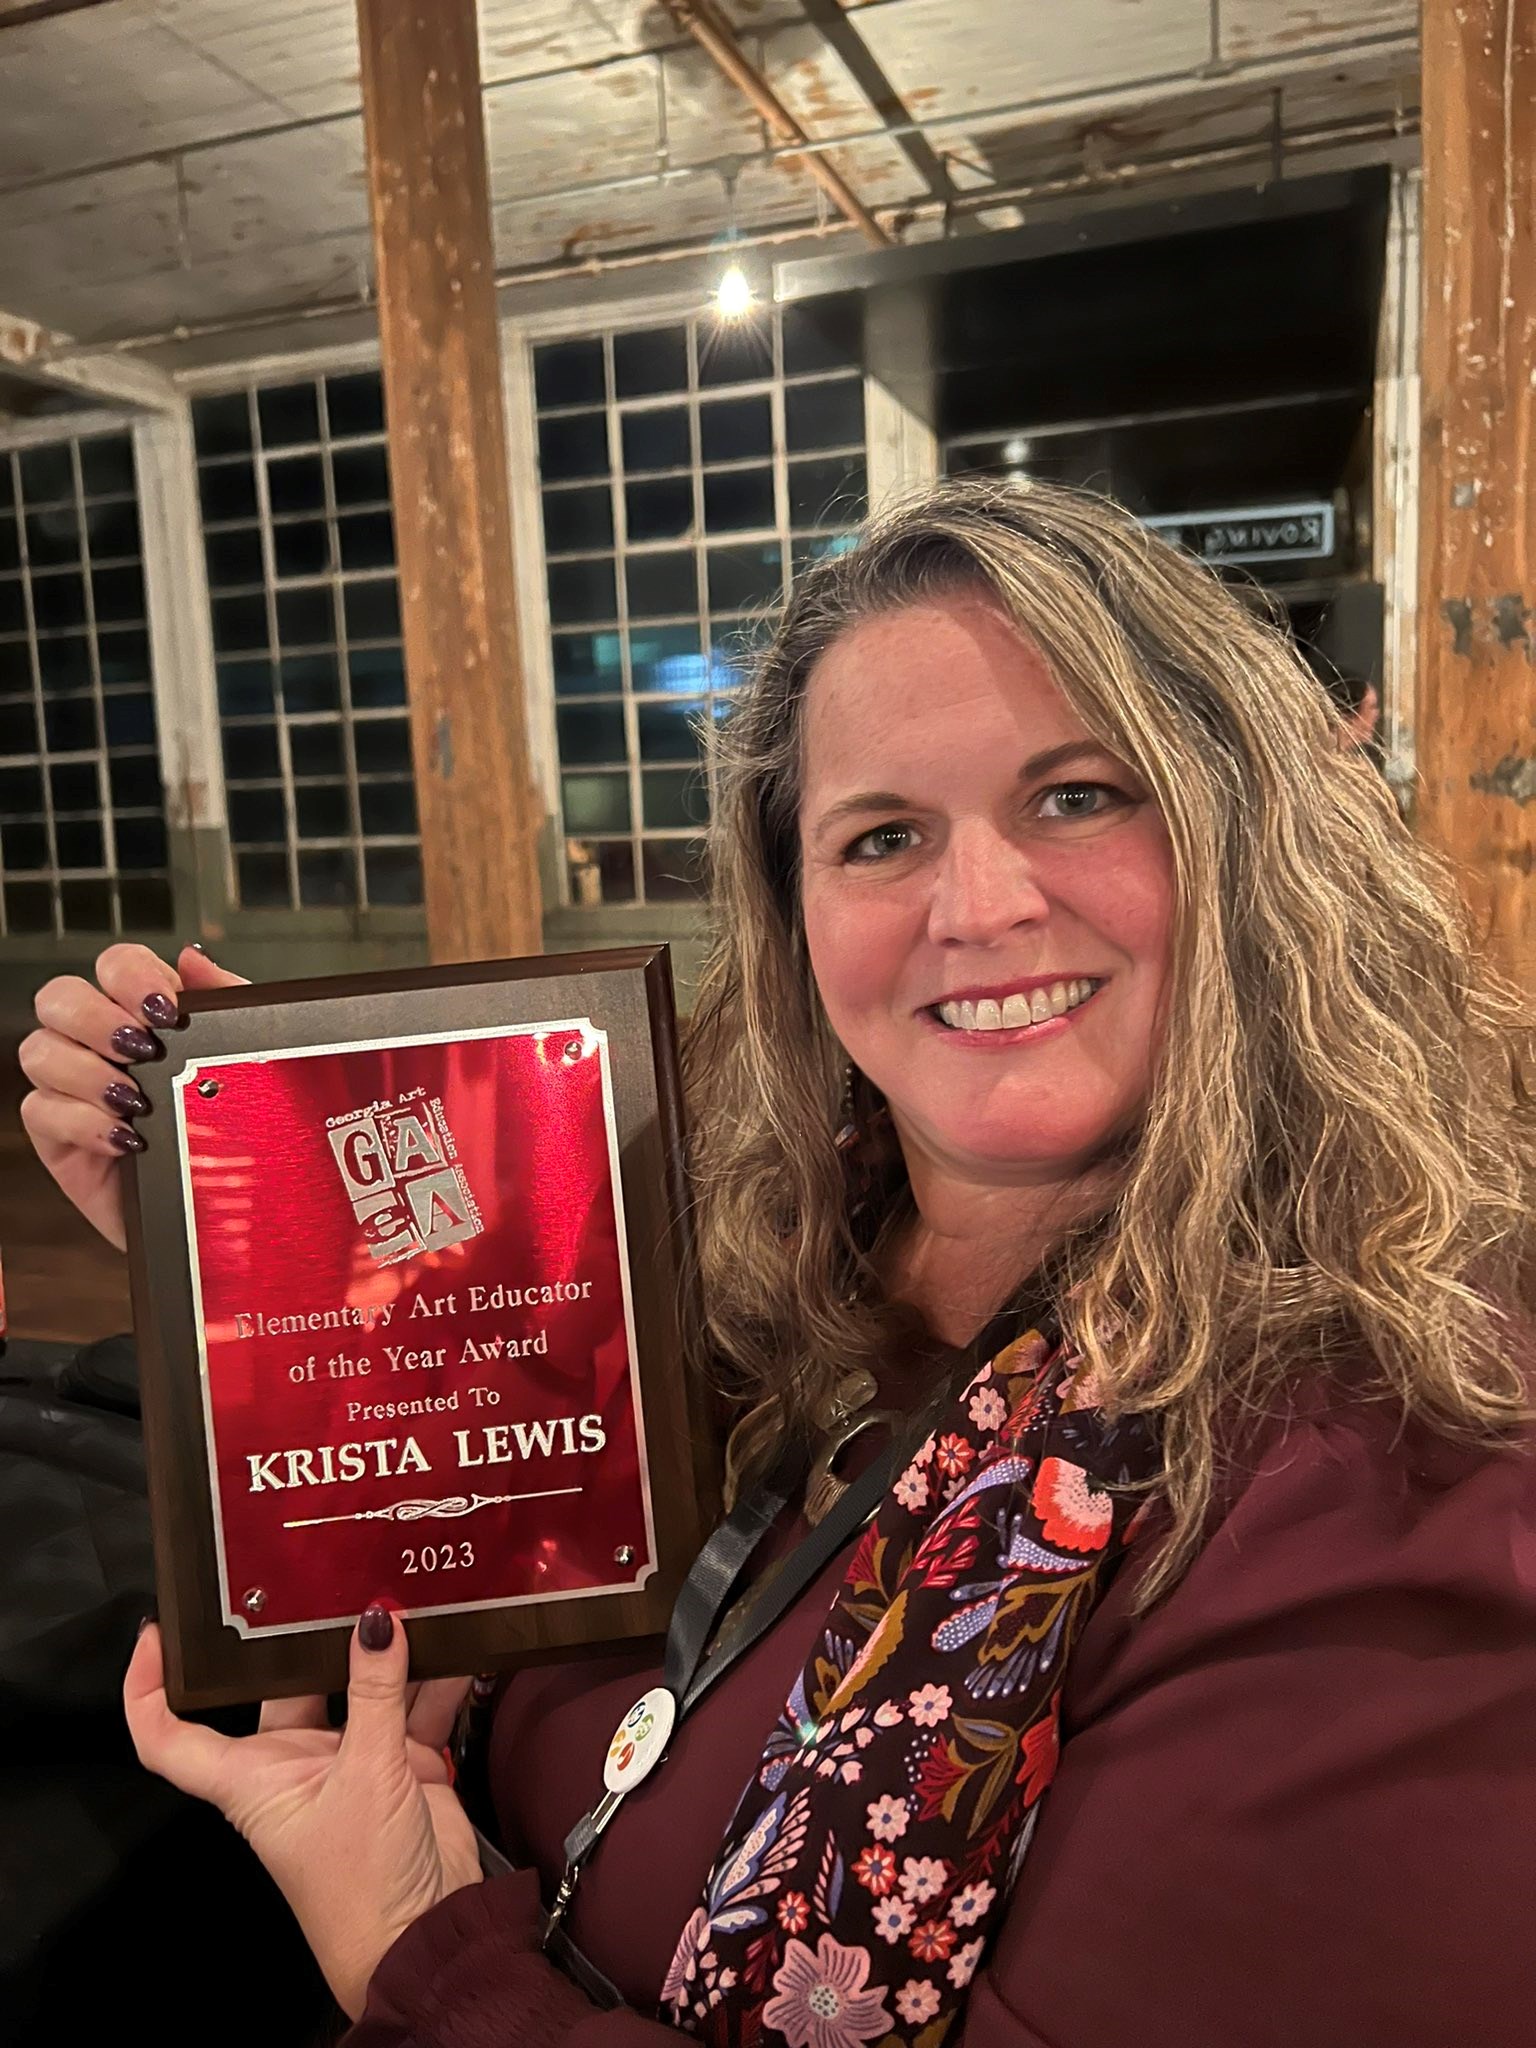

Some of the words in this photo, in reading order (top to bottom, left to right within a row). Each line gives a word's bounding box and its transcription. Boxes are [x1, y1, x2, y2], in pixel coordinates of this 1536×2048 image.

[325, 1099, 394, 1128] Georgia
[398, 1086, 427, 1105] Art
[429, 1097, 458, 1160] Education
[453, 1163, 485, 1235] Association
[235, 1301, 396, 1339] Elementary
[409, 1292, 457, 1320] Art
[469, 1280, 593, 1313] Educator
[288, 1356, 316, 1384] of
[328, 1353, 372, 1379] the
[382, 1345, 447, 1374] Year
[459, 1329, 549, 1364] Award
[346, 1391, 460, 1422] Presented
[468, 1386, 501, 1408] To
[246, 1435, 432, 1493] KRISTA
[453, 1413, 607, 1468] LEWIS
[400, 1540, 476, 1575] 2023
